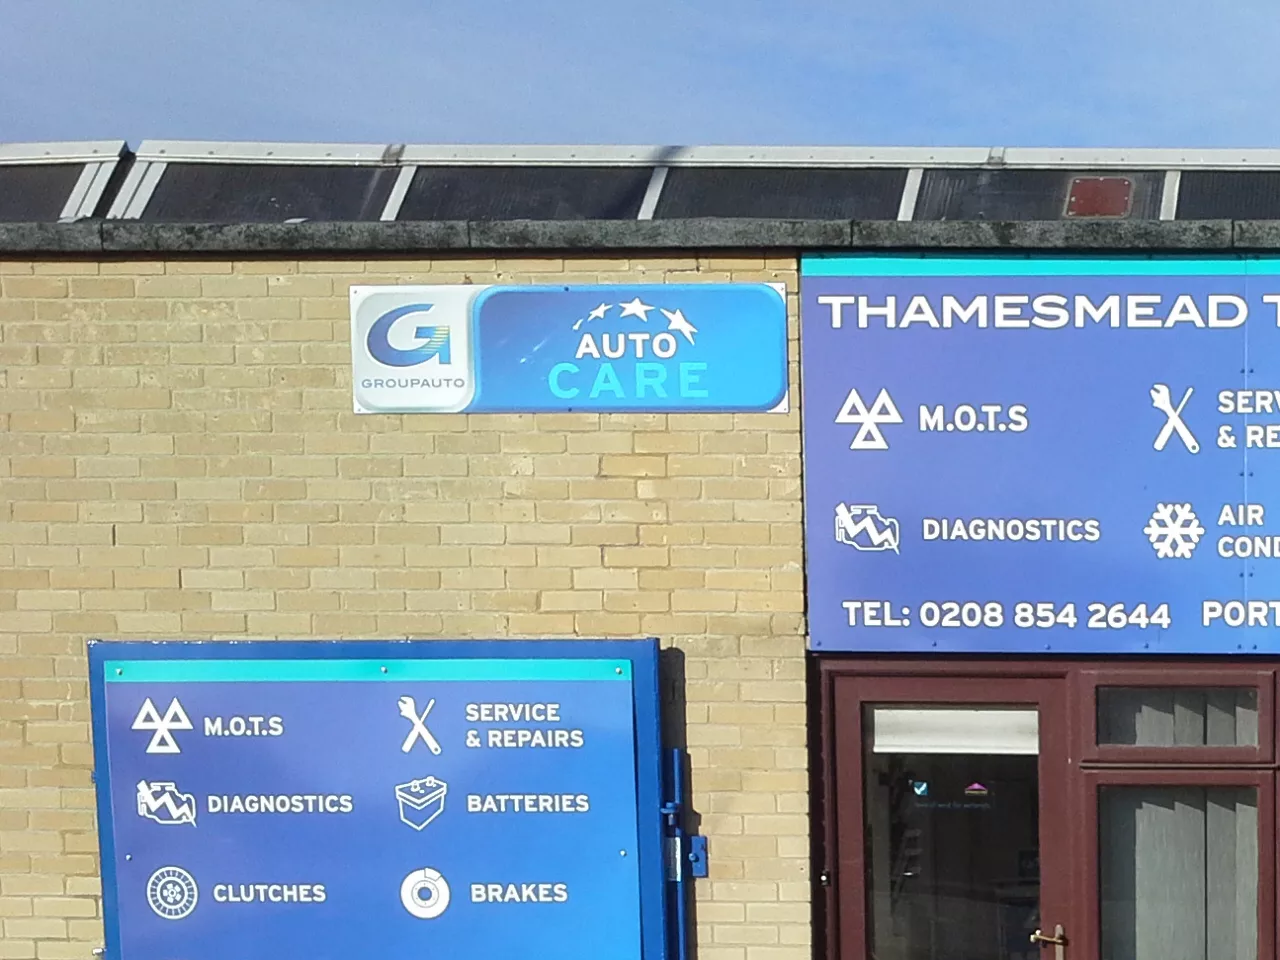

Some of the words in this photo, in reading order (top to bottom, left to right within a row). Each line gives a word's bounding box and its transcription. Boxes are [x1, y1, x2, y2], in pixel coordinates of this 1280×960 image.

[818, 294, 1249, 330] THAMESMEAD
[575, 332, 678, 359] AUTO
[360, 377, 466, 389] GROUPAUTO
[547, 362, 710, 399] CARE
[919, 404, 1029, 433] M.O.T.S
[1217, 425, 1238, 449] &
[1217, 506, 1264, 527] AIR
[921, 518, 1101, 543] DIAGNOSTICS
[841, 600, 911, 627] TEL:
[919, 601, 1004, 628] 0208
[1013, 601, 1078, 628] 854
[1087, 602, 1172, 630] 2644
[465, 703, 560, 722] SERVICE
[203, 715, 284, 737] M.O.T.S
[465, 730, 481, 748] &
[488, 729, 584, 748] REPAIRS
[207, 794, 354, 814] DIAGNOSTICS
[466, 793, 590, 813] BATTERIES
[212, 883, 326, 903] CLUTCHES
[470, 883, 568, 903] BRAKES
